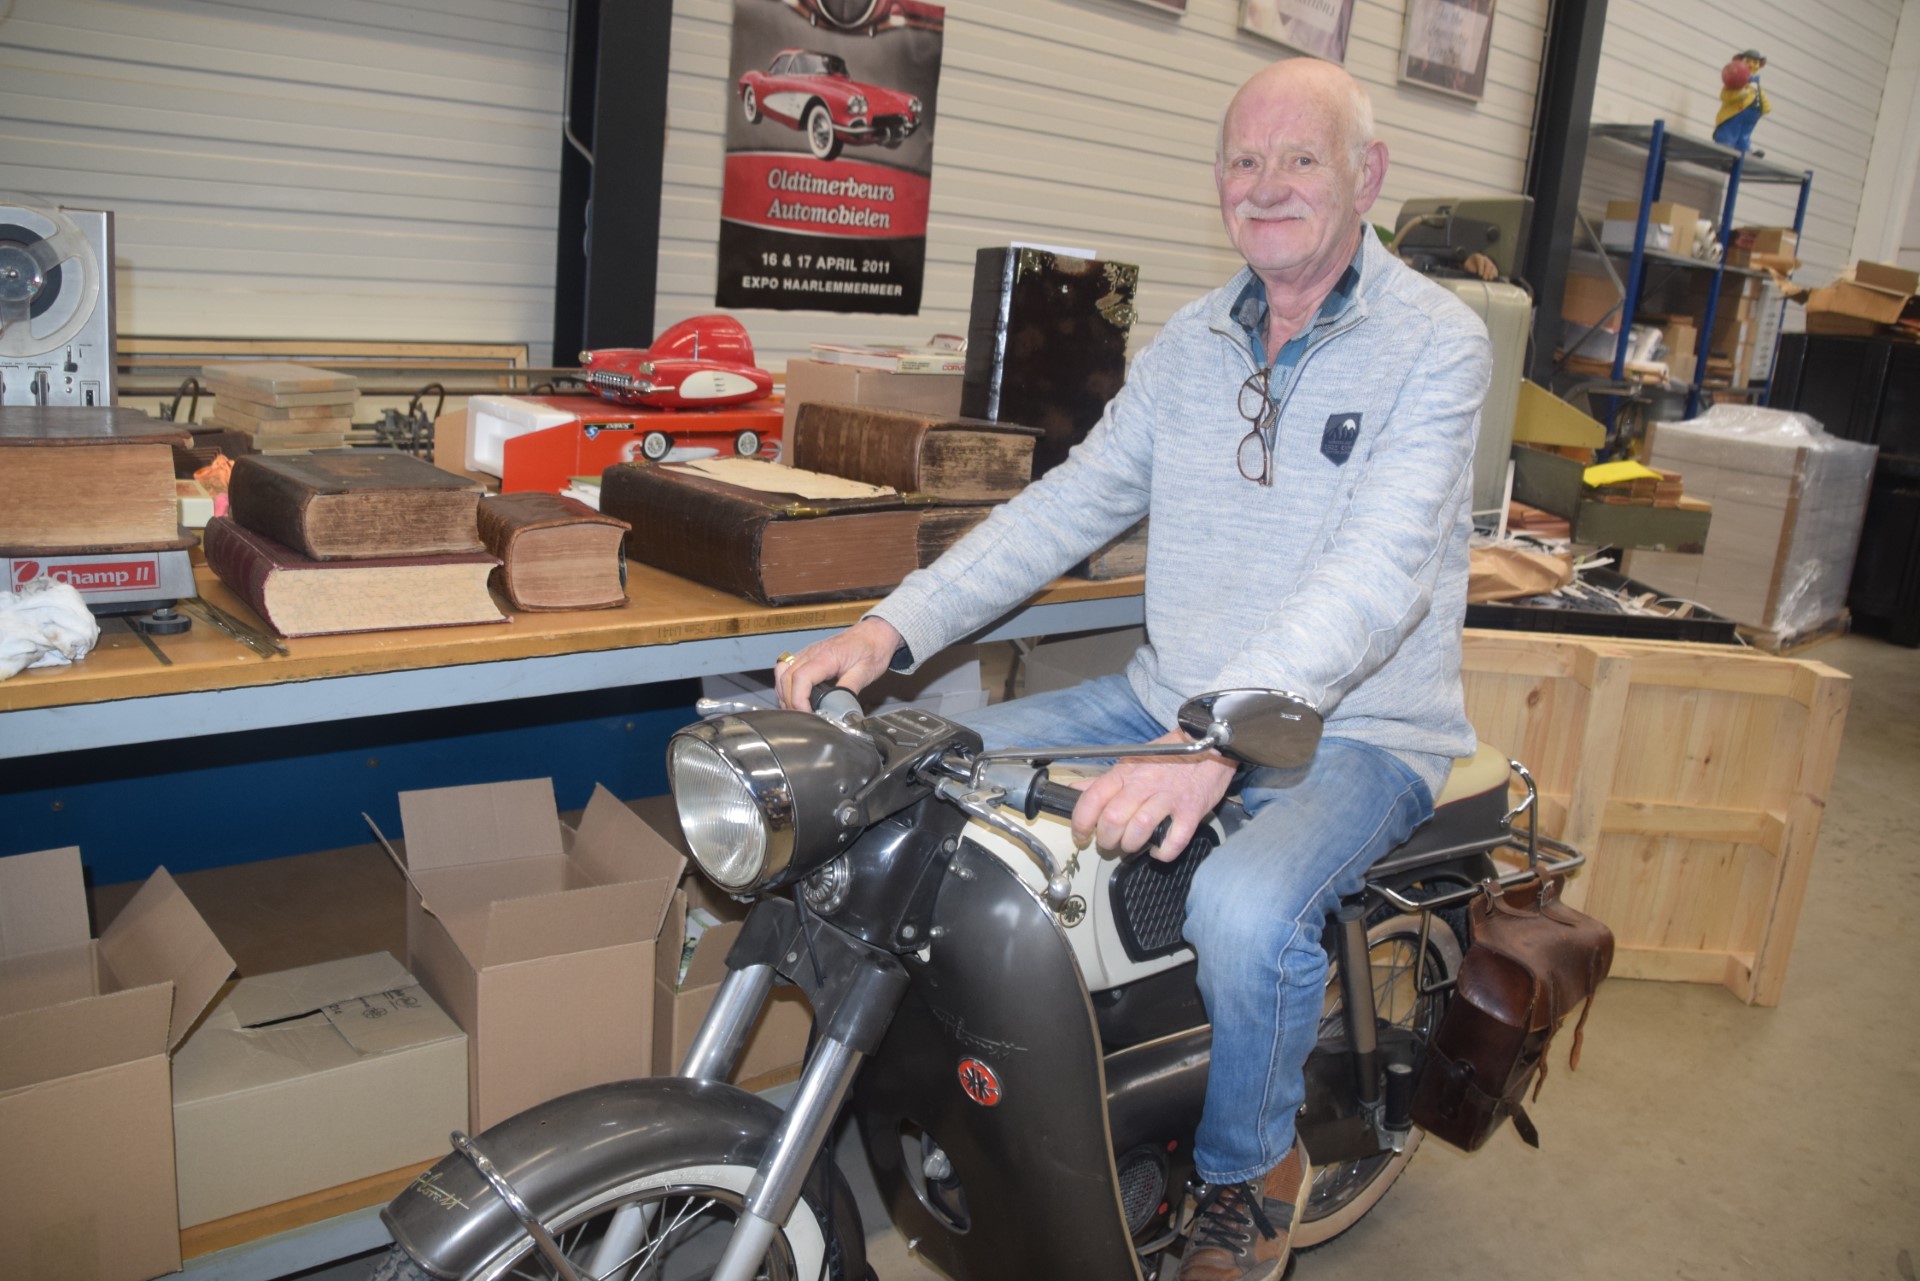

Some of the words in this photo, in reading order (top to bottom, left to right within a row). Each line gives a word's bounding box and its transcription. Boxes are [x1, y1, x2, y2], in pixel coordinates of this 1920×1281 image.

[767, 168, 895, 201] Oldtimerbeurs
[767, 198, 890, 229] Automobielen
[761, 252, 777, 267] 16
[782, 253, 792, 267] &
[797, 254, 812, 268] 17
[816, 256, 858, 271] APRIL
[862, 259, 890, 274] 2011
[742, 276, 779, 289] EXPO
[783, 278, 903, 296] HAARLEMMERMEER
[51, 570, 129, 586] Champ
[136, 567, 149, 581] II
